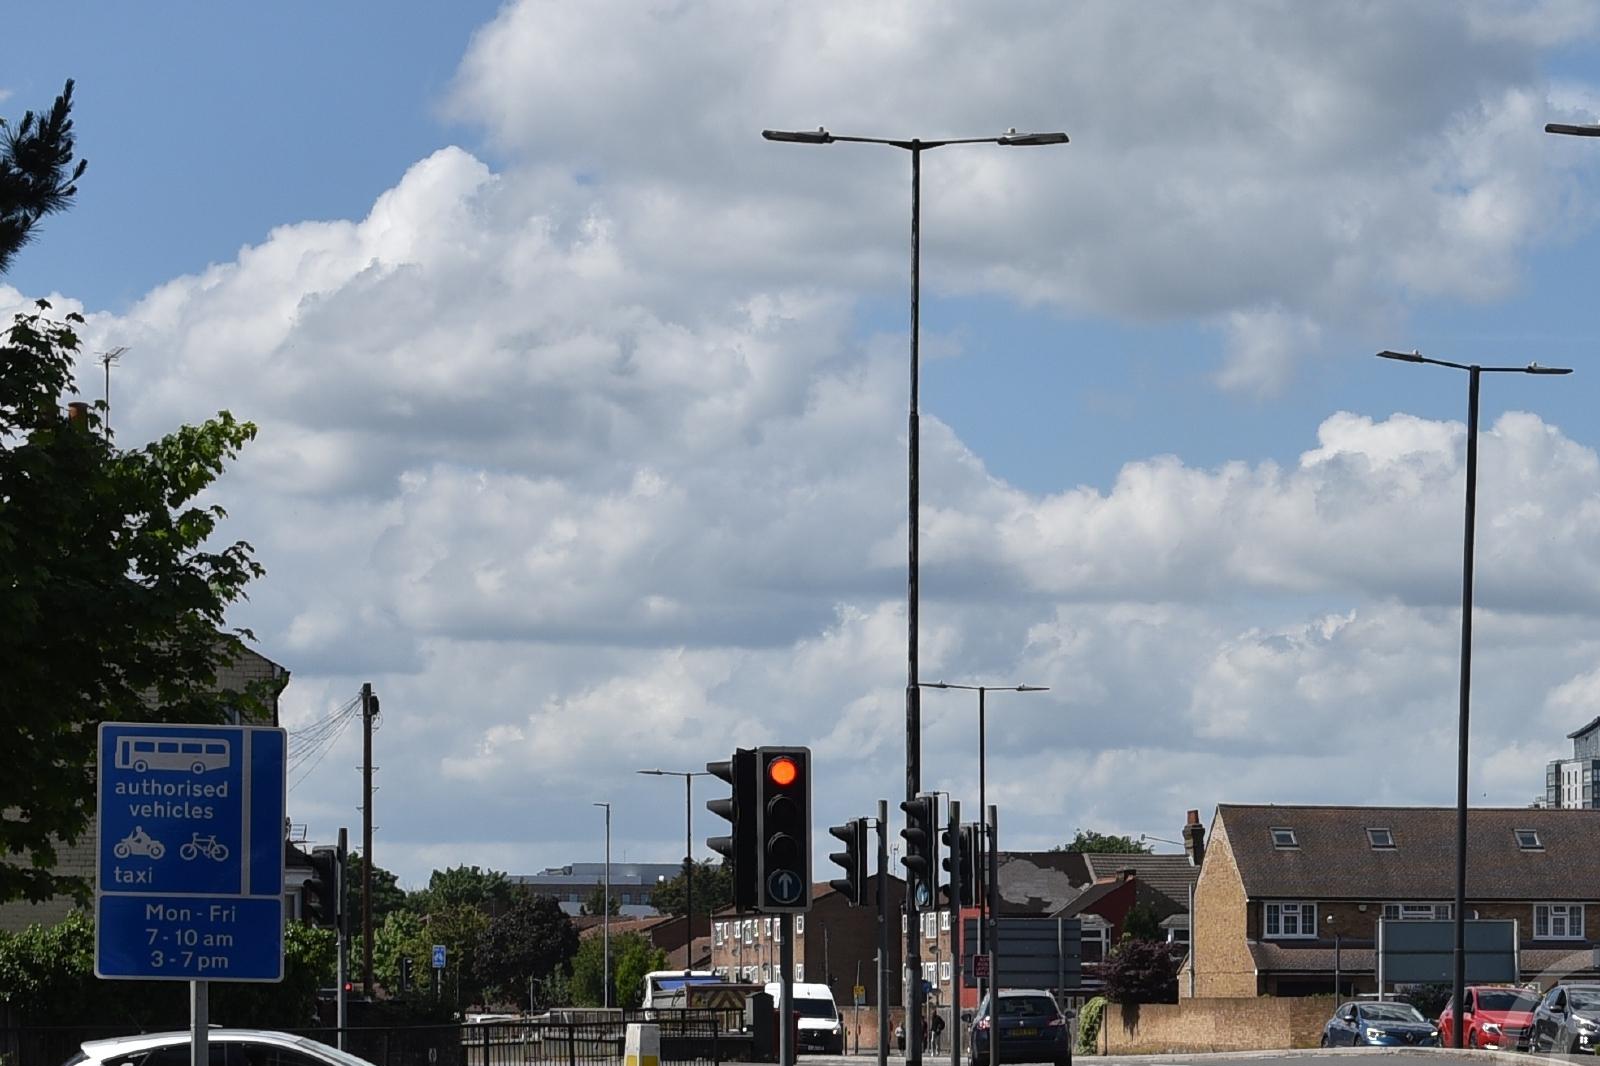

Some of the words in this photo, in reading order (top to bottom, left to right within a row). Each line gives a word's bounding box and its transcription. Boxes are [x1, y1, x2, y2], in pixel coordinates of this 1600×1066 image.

[115, 778, 228, 798] authorised
[129, 800, 214, 819] vehicles
[114, 865, 153, 884] taxi
[146, 903, 191, 922] Mon
[209, 904, 236, 922] Fri
[146, 928, 158, 945] 7
[175, 928, 198, 946] 10
[203, 934, 233, 947] am
[151, 950, 164, 968] 3
[181, 951, 193, 968] 7
[197, 955, 229, 972] pm
